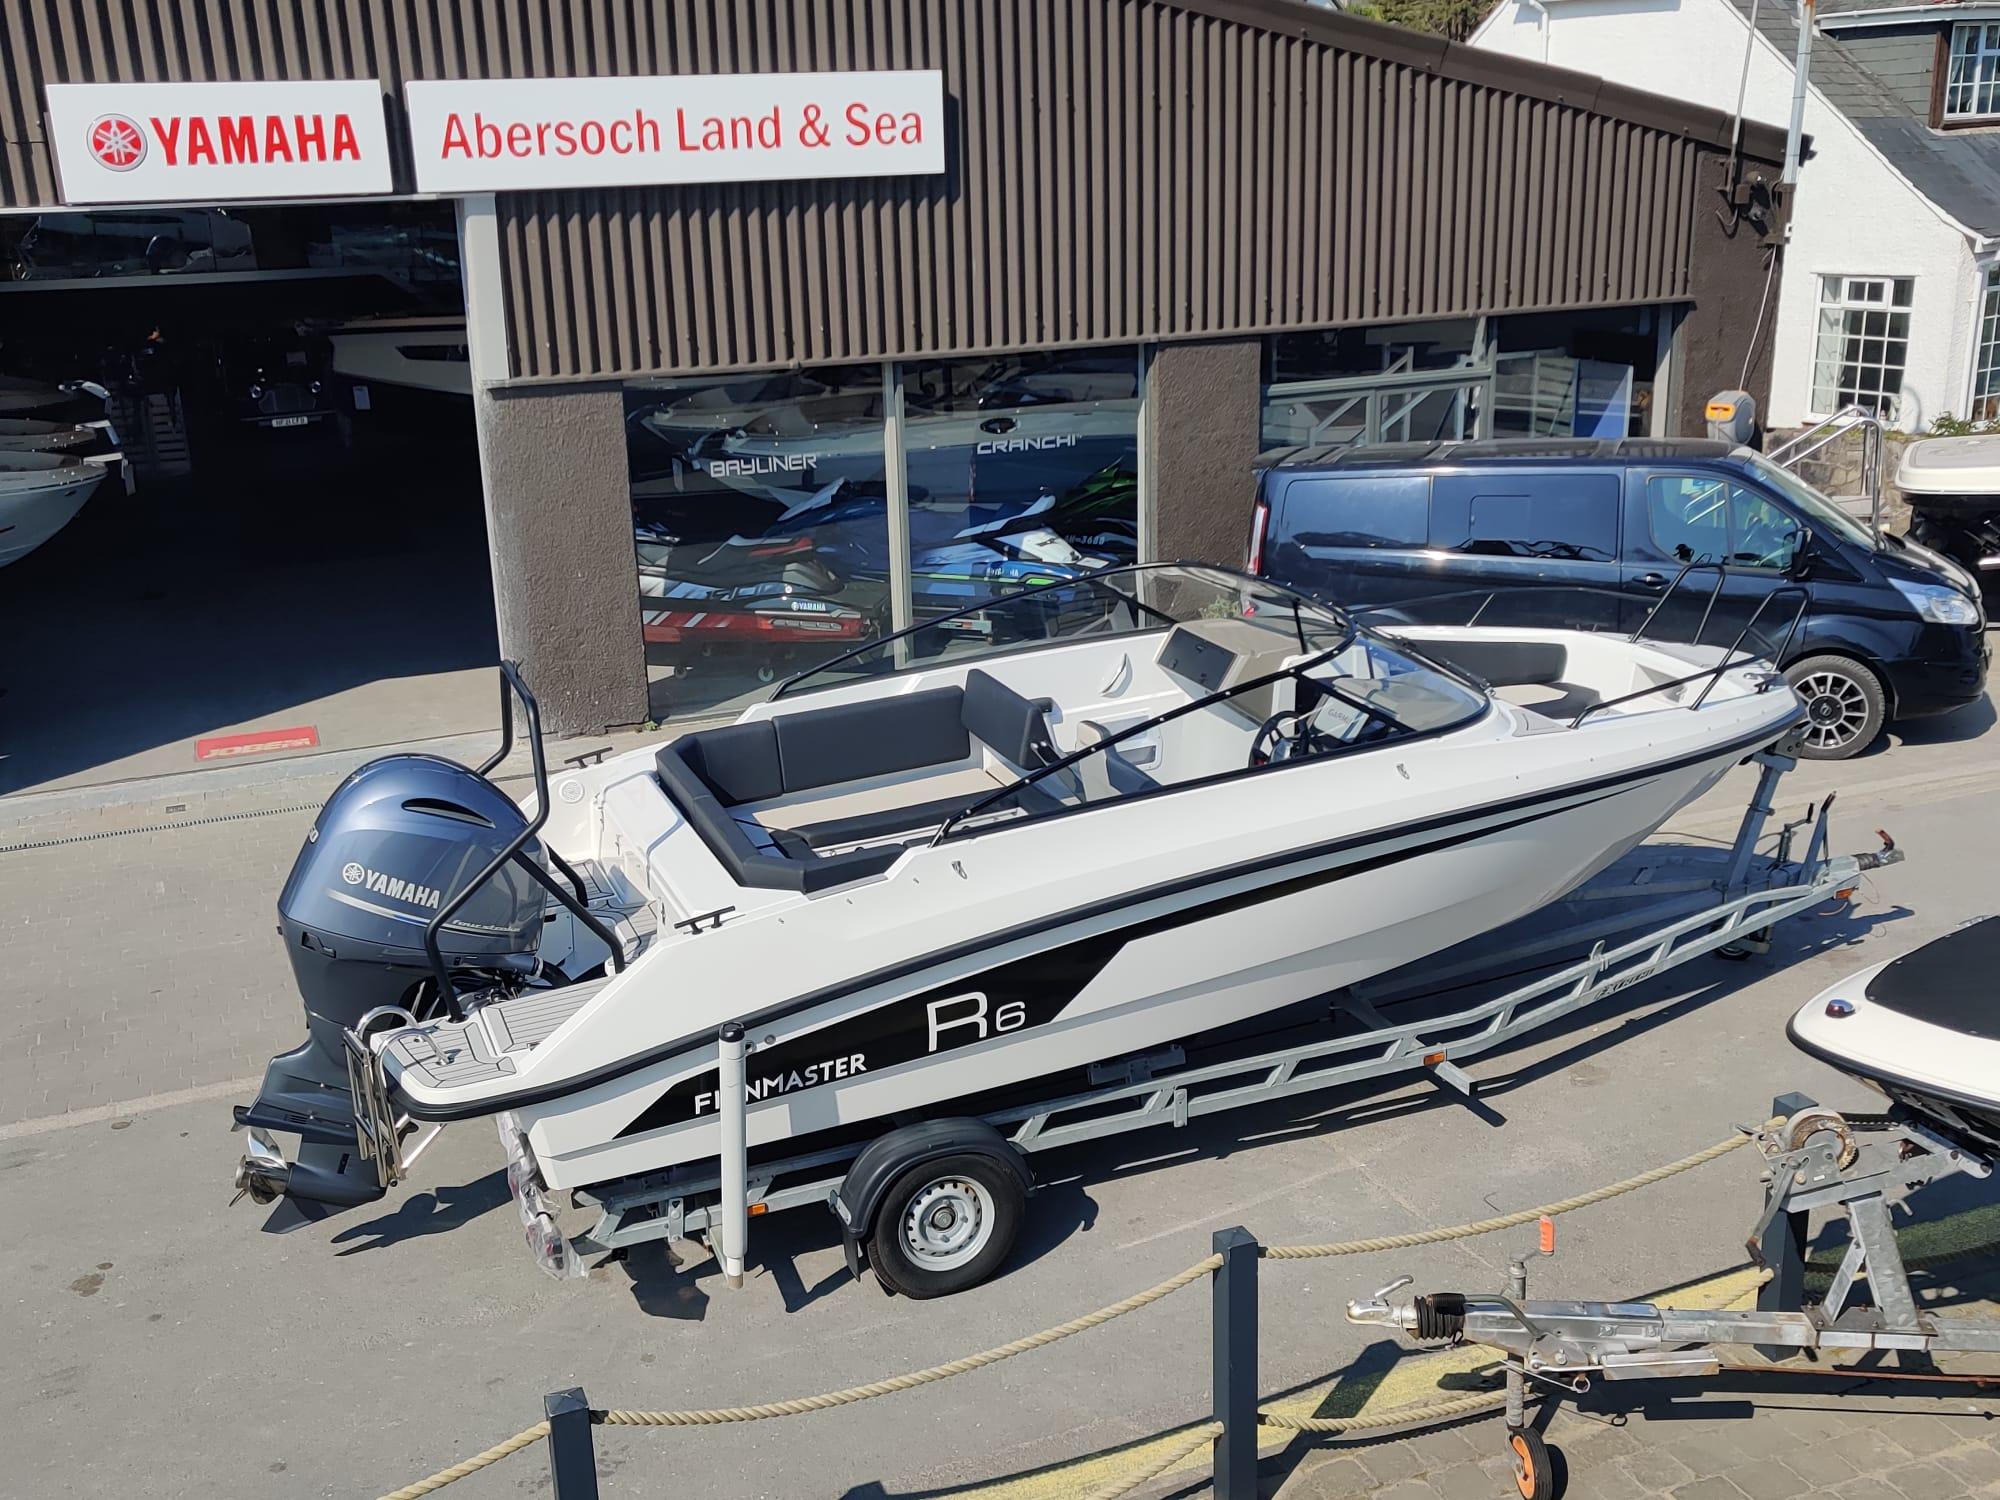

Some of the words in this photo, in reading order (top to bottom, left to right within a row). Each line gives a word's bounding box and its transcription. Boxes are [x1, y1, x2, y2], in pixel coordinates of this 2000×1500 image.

[150, 114, 361, 166] YAMAHA
[441, 108, 661, 160] Abersoch
[677, 105, 783, 152] Land
[800, 104, 831, 148] &
[845, 102, 923, 146] Sea
[710, 453, 817, 478] BAYLINER
[977, 434, 1076, 455] CRANCHI
[799, 602, 826, 611] YAMAHA
[365, 869, 440, 909] YAMAHA
[926, 991, 1026, 1052] R6
[694, 1052, 867, 1115] FINMASTER
